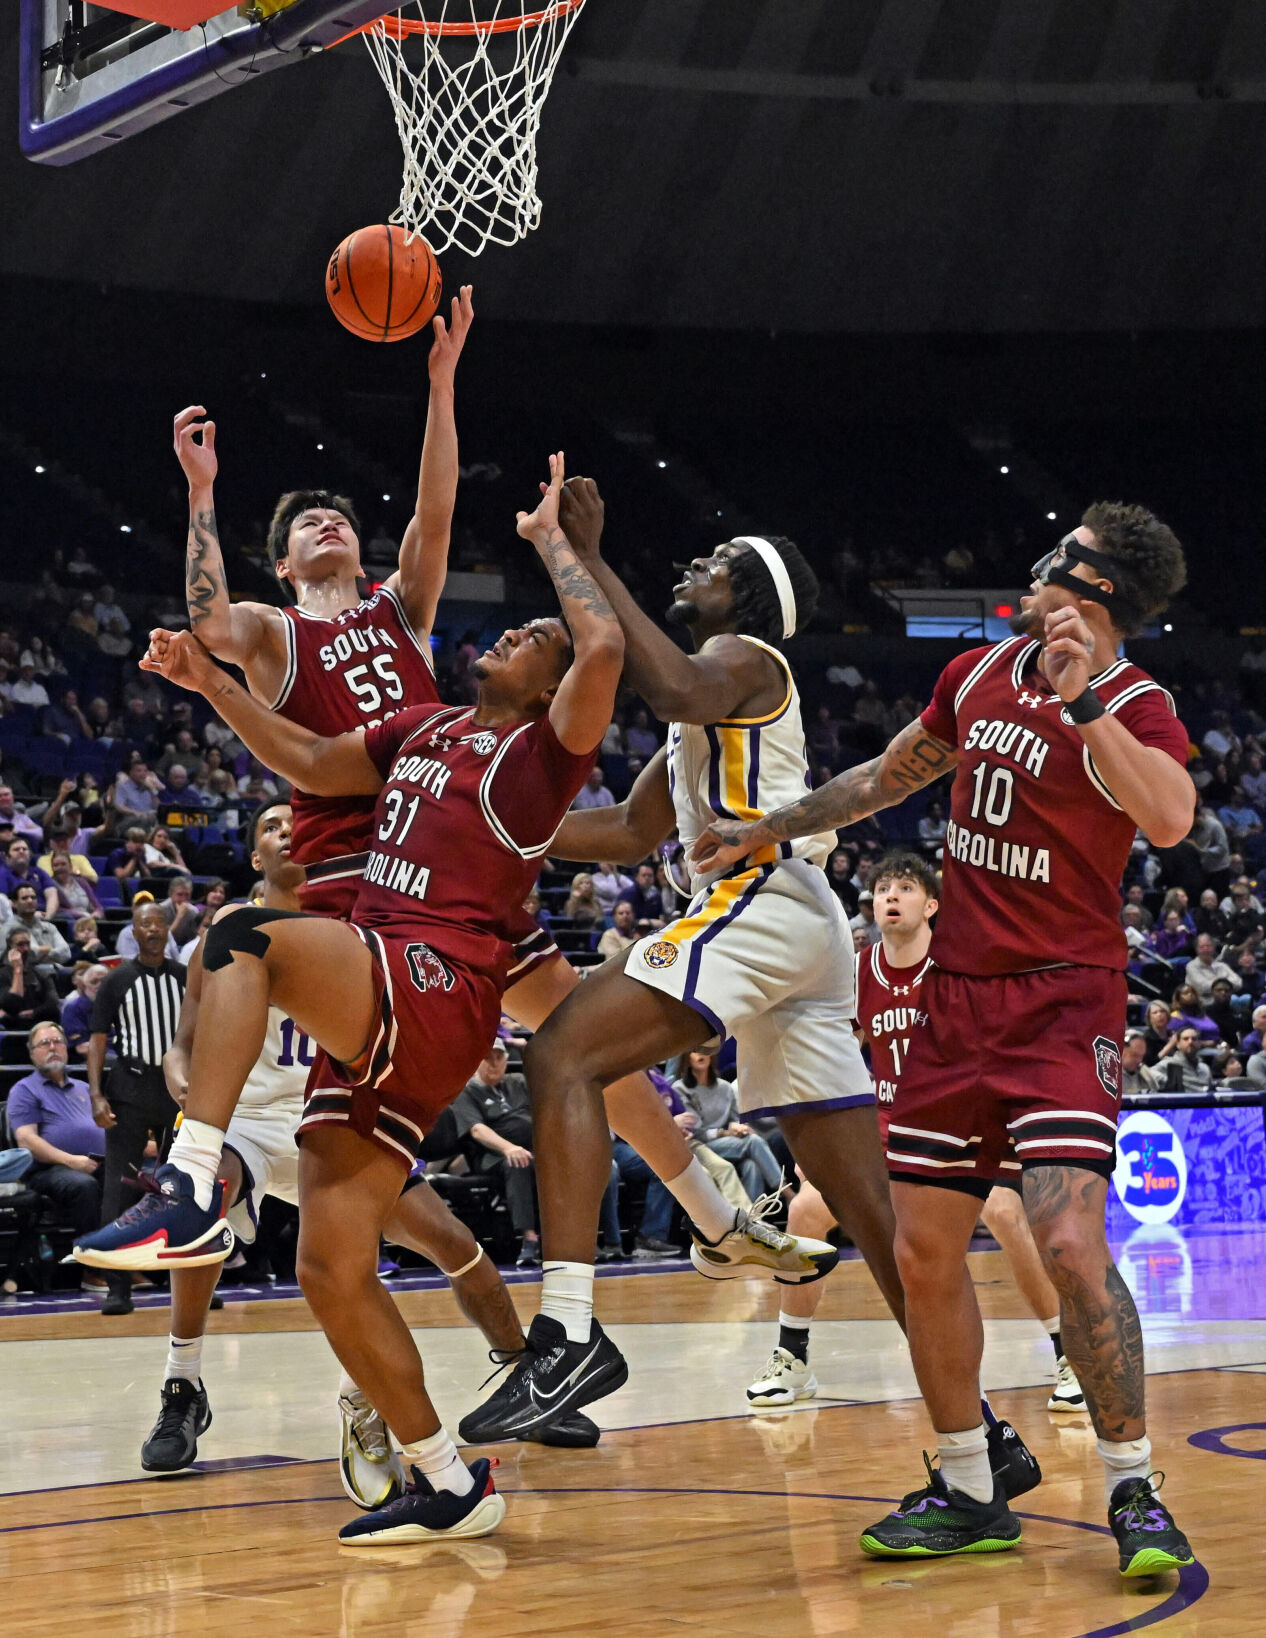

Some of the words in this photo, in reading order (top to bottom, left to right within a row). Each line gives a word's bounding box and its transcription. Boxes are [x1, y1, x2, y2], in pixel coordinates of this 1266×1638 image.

[319, 624, 399, 671] SOUTH
[343, 653, 404, 713] 55
[474, 734, 496, 754] SEC
[964, 719, 1050, 779] SOUTH
[386, 755, 452, 800] SOUTH
[970, 761, 1014, 827] 10
[378, 789, 420, 846] 31
[946, 819, 1050, 884] CAROLINA
[871, 1007, 917, 1037] SOUT
[1118, 1131, 1181, 1208] 35
[1143, 1171, 1177, 1194] Years
